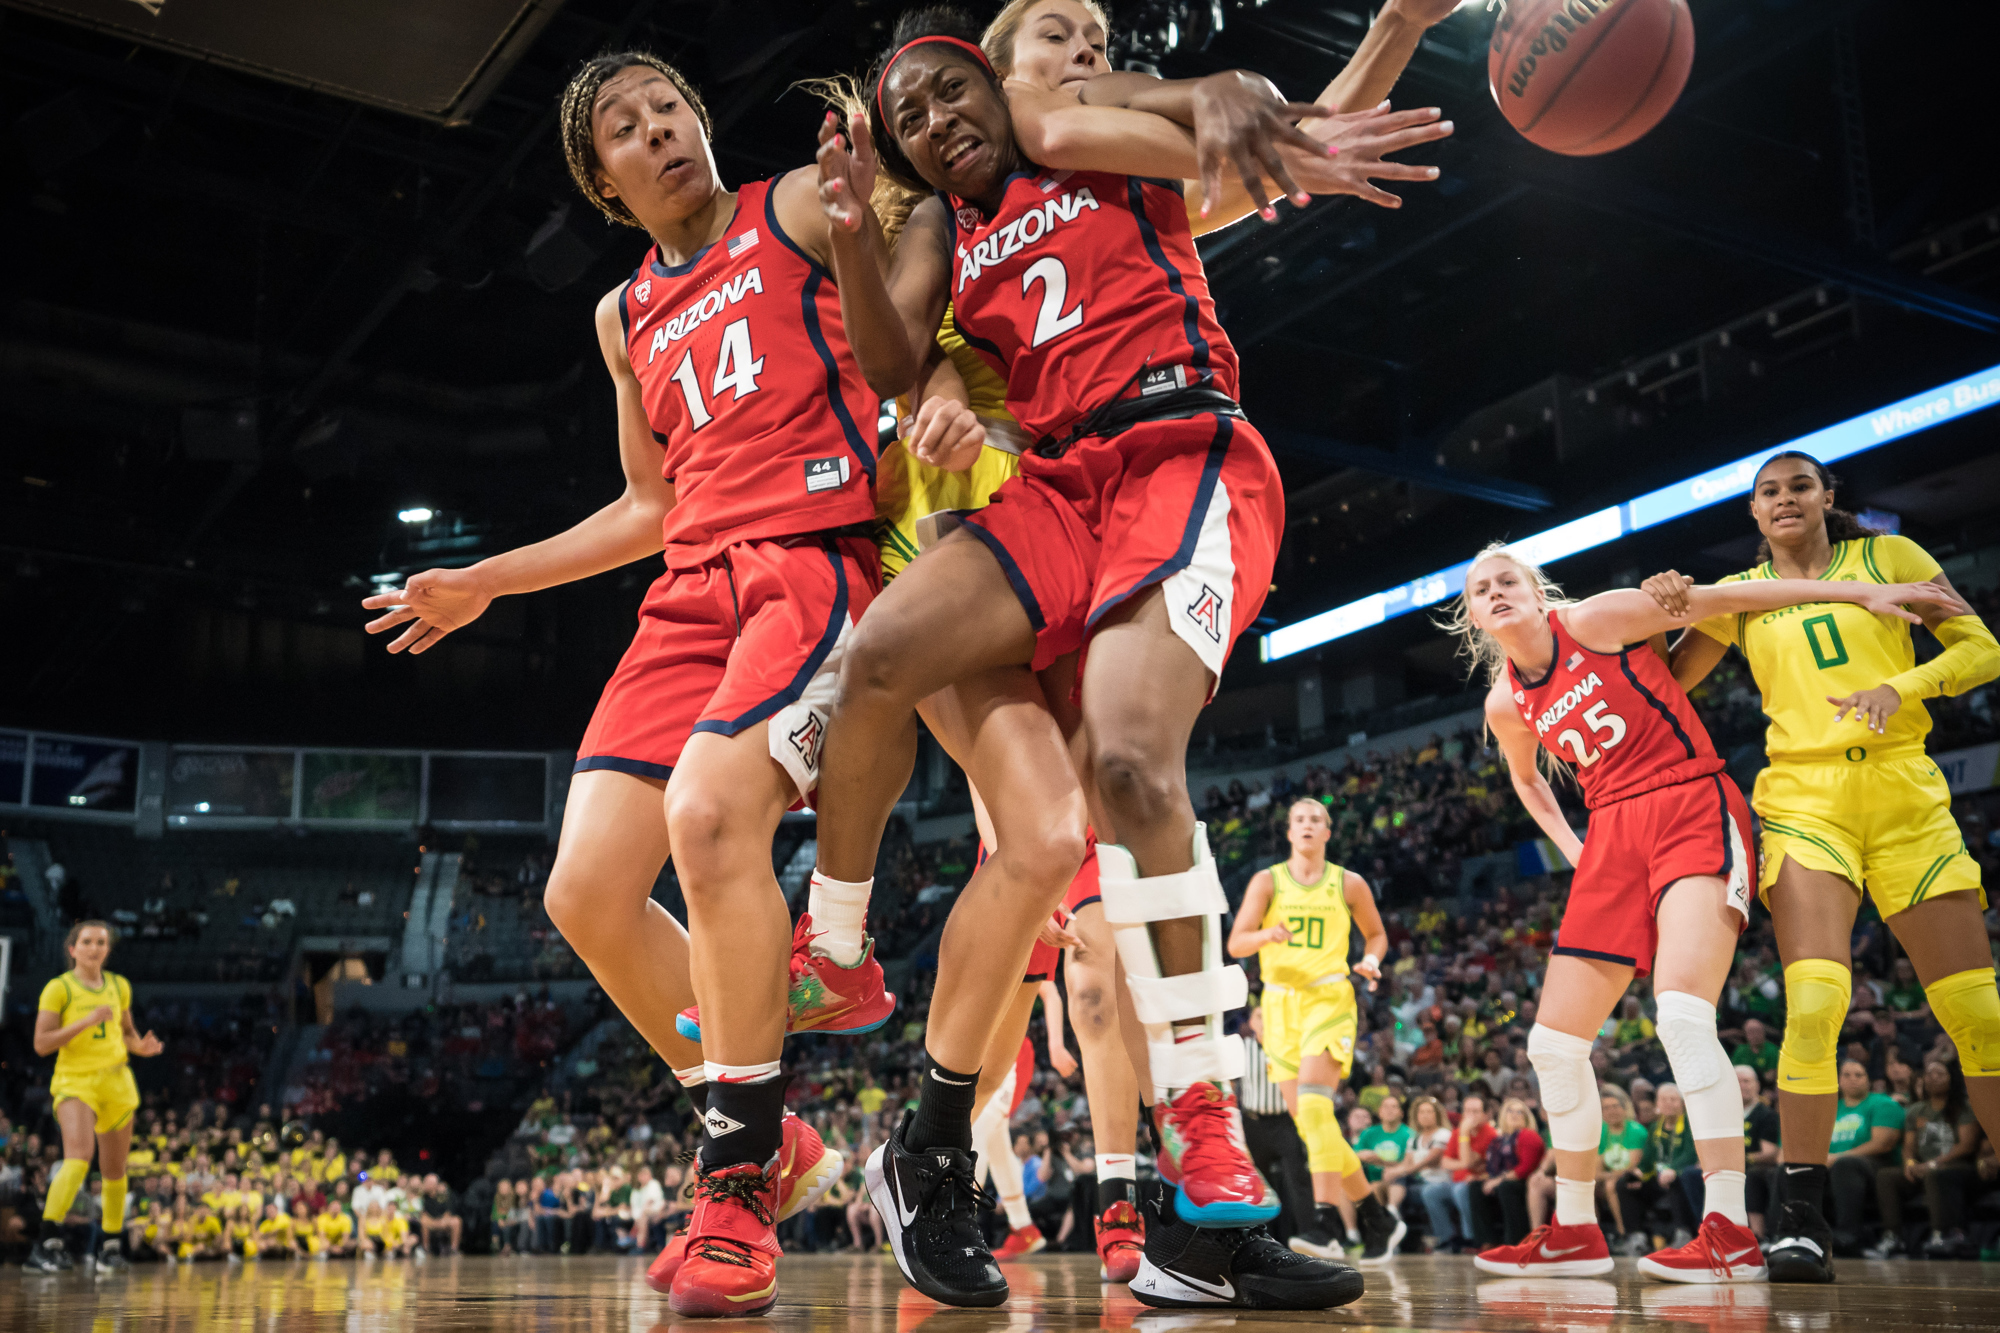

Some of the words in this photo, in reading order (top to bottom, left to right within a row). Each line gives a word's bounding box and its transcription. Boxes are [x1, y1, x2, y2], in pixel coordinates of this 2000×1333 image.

[957, 186, 1100, 296] ARIZONA
[648, 266, 765, 366] ARIZONA
[1021, 256, 1084, 349] 2
[670, 315, 767, 432] 14
[1146, 370, 1167, 383] 42
[1870, 396, 1951, 437] Where
[812, 461, 831, 473] 44
[1802, 612, 1850, 671] 0
[1535, 671, 1604, 738] ARIZONA
[1557, 698, 1628, 768] 25
[1287, 916, 1325, 949] 20
[1145, 1279, 1156, 1290] 24
